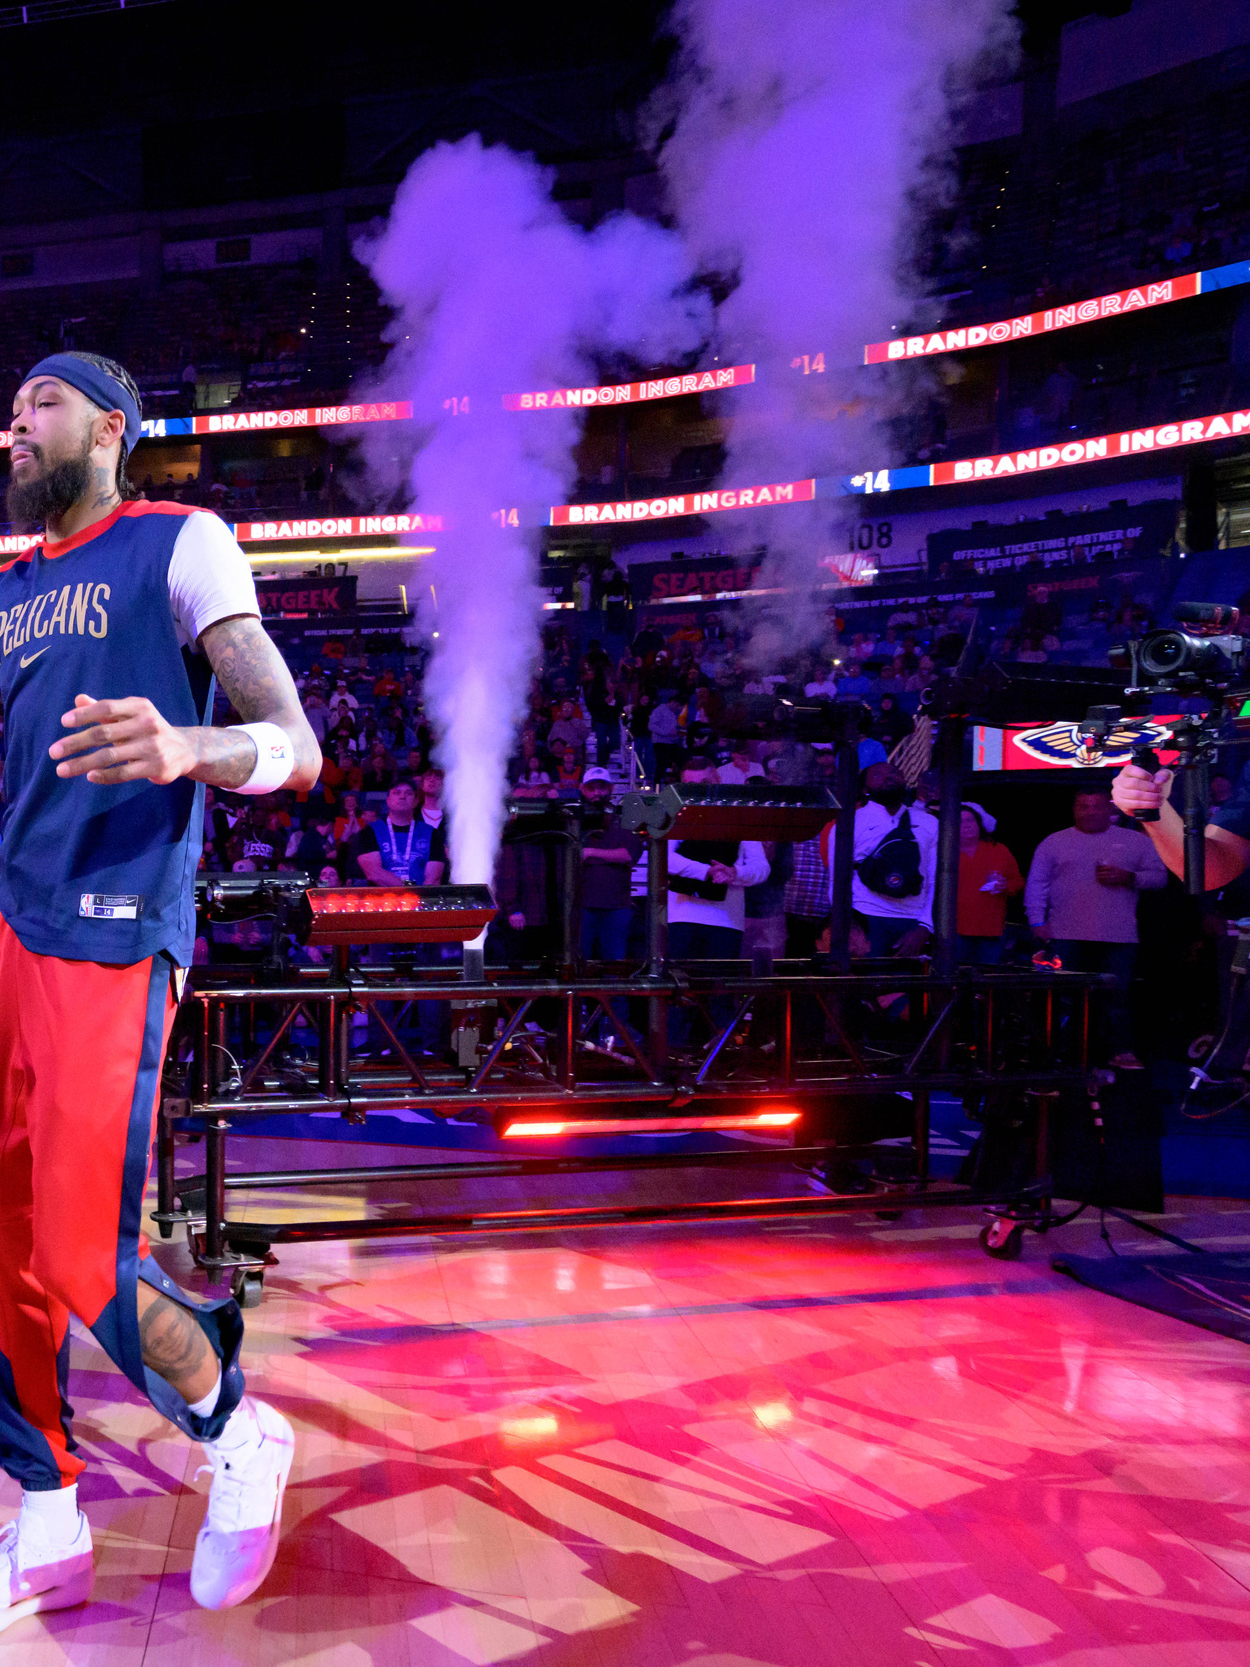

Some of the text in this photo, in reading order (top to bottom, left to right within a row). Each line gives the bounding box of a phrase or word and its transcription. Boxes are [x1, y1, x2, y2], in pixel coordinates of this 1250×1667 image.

[887, 281, 1173, 360] BRANDON INGRAM
[520, 368, 735, 410] BRANDON INGRAM
[208, 402, 397, 431] BRANDON INGRAM
[953, 411, 1250, 481] BRANDON INGRAM
[568, 483, 794, 524] BRANDON INGRAM
[250, 514, 443, 540] BRANDON INGRAM
[1126, 526, 1144, 538] OF
[652, 566, 762, 598] SEATGE
[259, 587, 341, 611] ATGEEK
